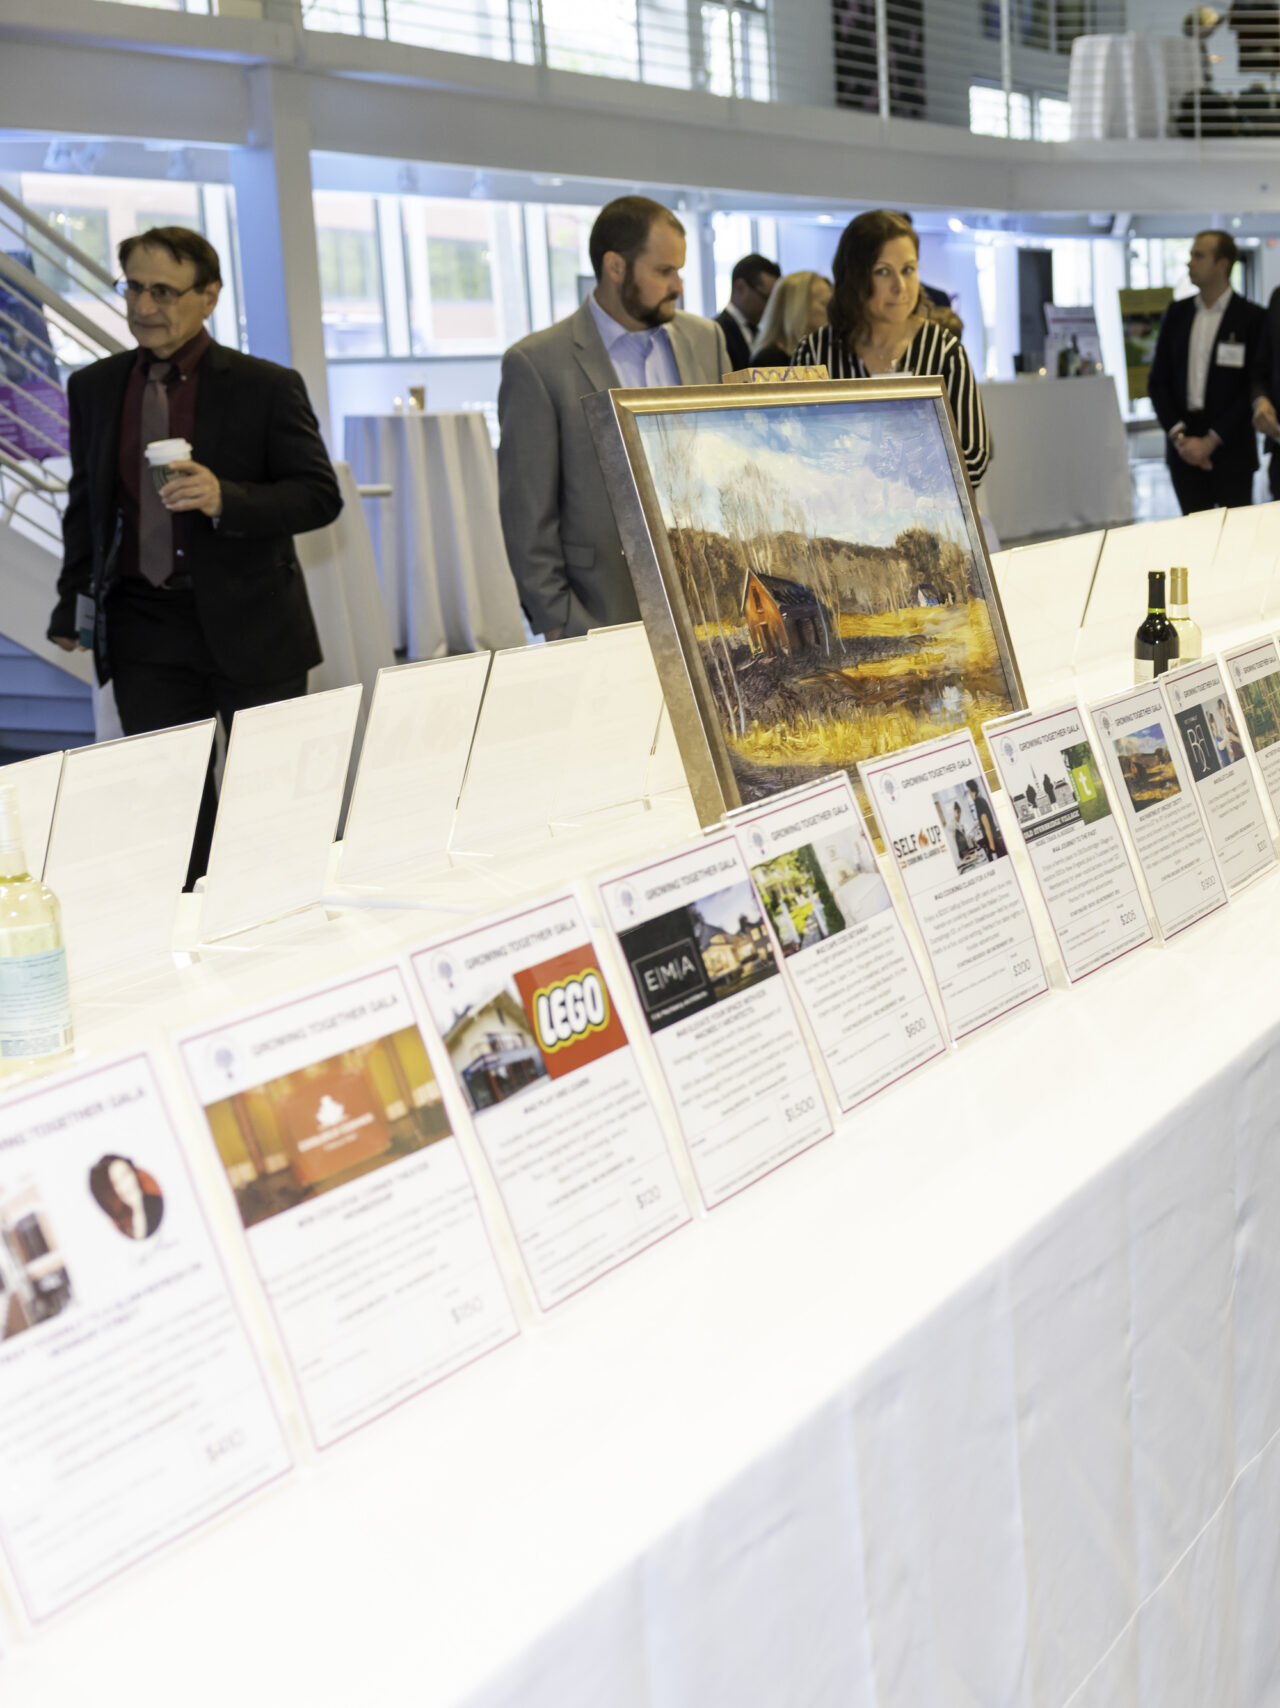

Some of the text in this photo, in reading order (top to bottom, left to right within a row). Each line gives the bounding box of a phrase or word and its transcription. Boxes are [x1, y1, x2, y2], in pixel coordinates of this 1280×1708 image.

[1115, 715, 1133, 726] GROWING
[1133, 707, 1152, 719] TOGETHER
[1019, 738, 1042, 750] GROWING
[1042, 729, 1067, 742] TOGETHER
[901, 773, 928, 788] GROWING
[928, 763, 956, 778] TOGETHER
[771, 804, 849, 839] GROWING TOGETHER GALA
[893, 825, 944, 858] SELF UP
[645, 858, 737, 899] GROWING TOGETHER GALA
[536, 974, 607, 1048] LEGO
[905, 1018, 927, 1037] $600
